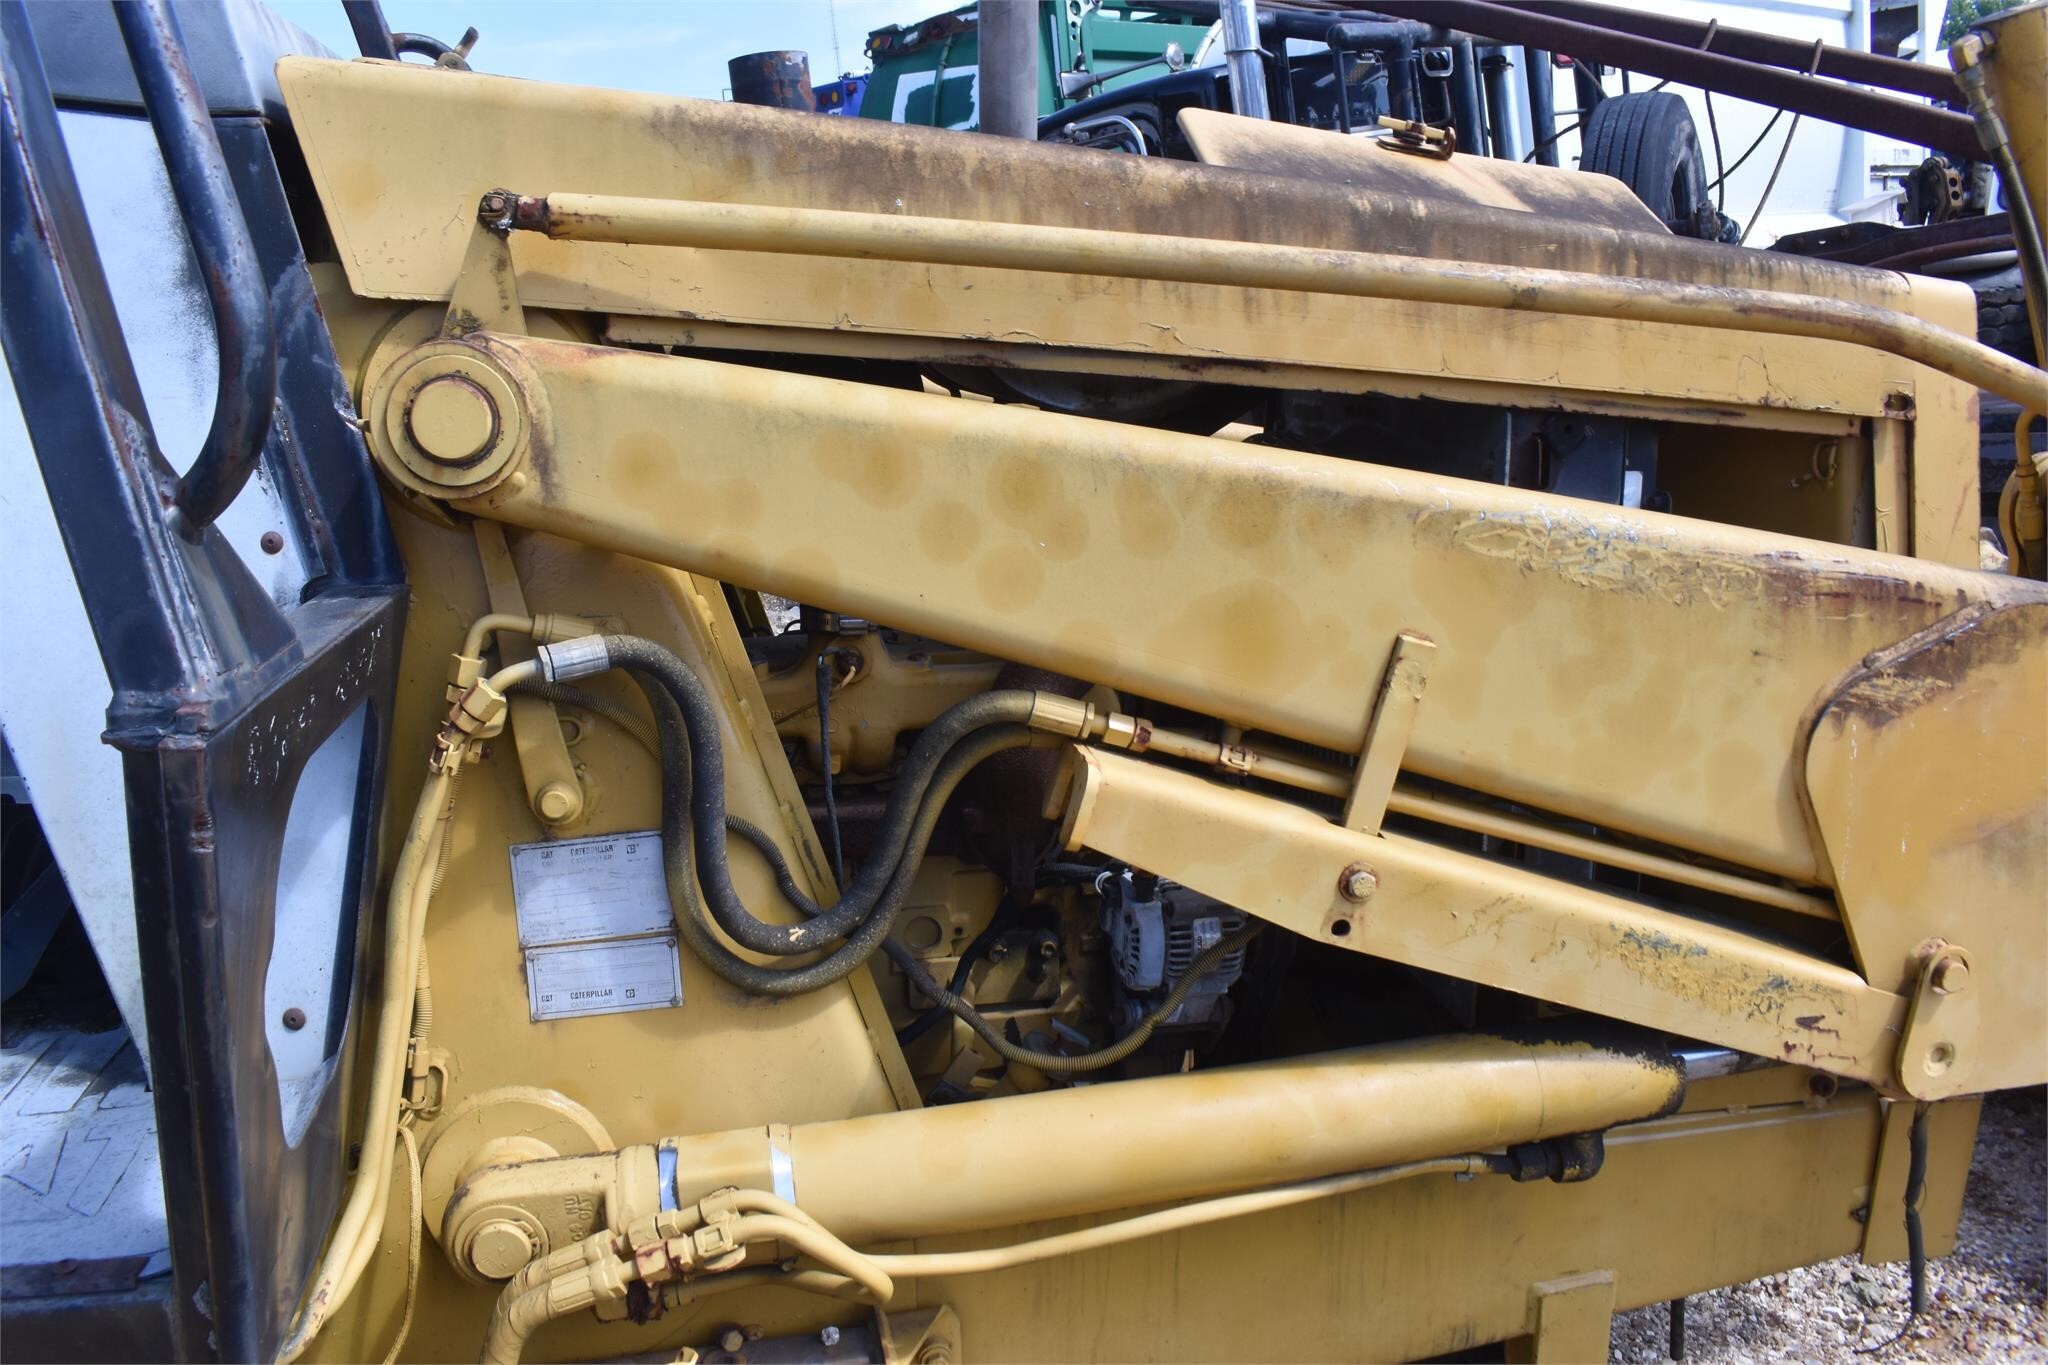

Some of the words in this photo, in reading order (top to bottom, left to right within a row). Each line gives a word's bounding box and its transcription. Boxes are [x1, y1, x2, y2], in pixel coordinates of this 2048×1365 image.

[570, 844, 614, 856] CATEILLAR
[541, 994, 553, 1003] CAT
[570, 988, 613, 1000] CATERPILLAR
